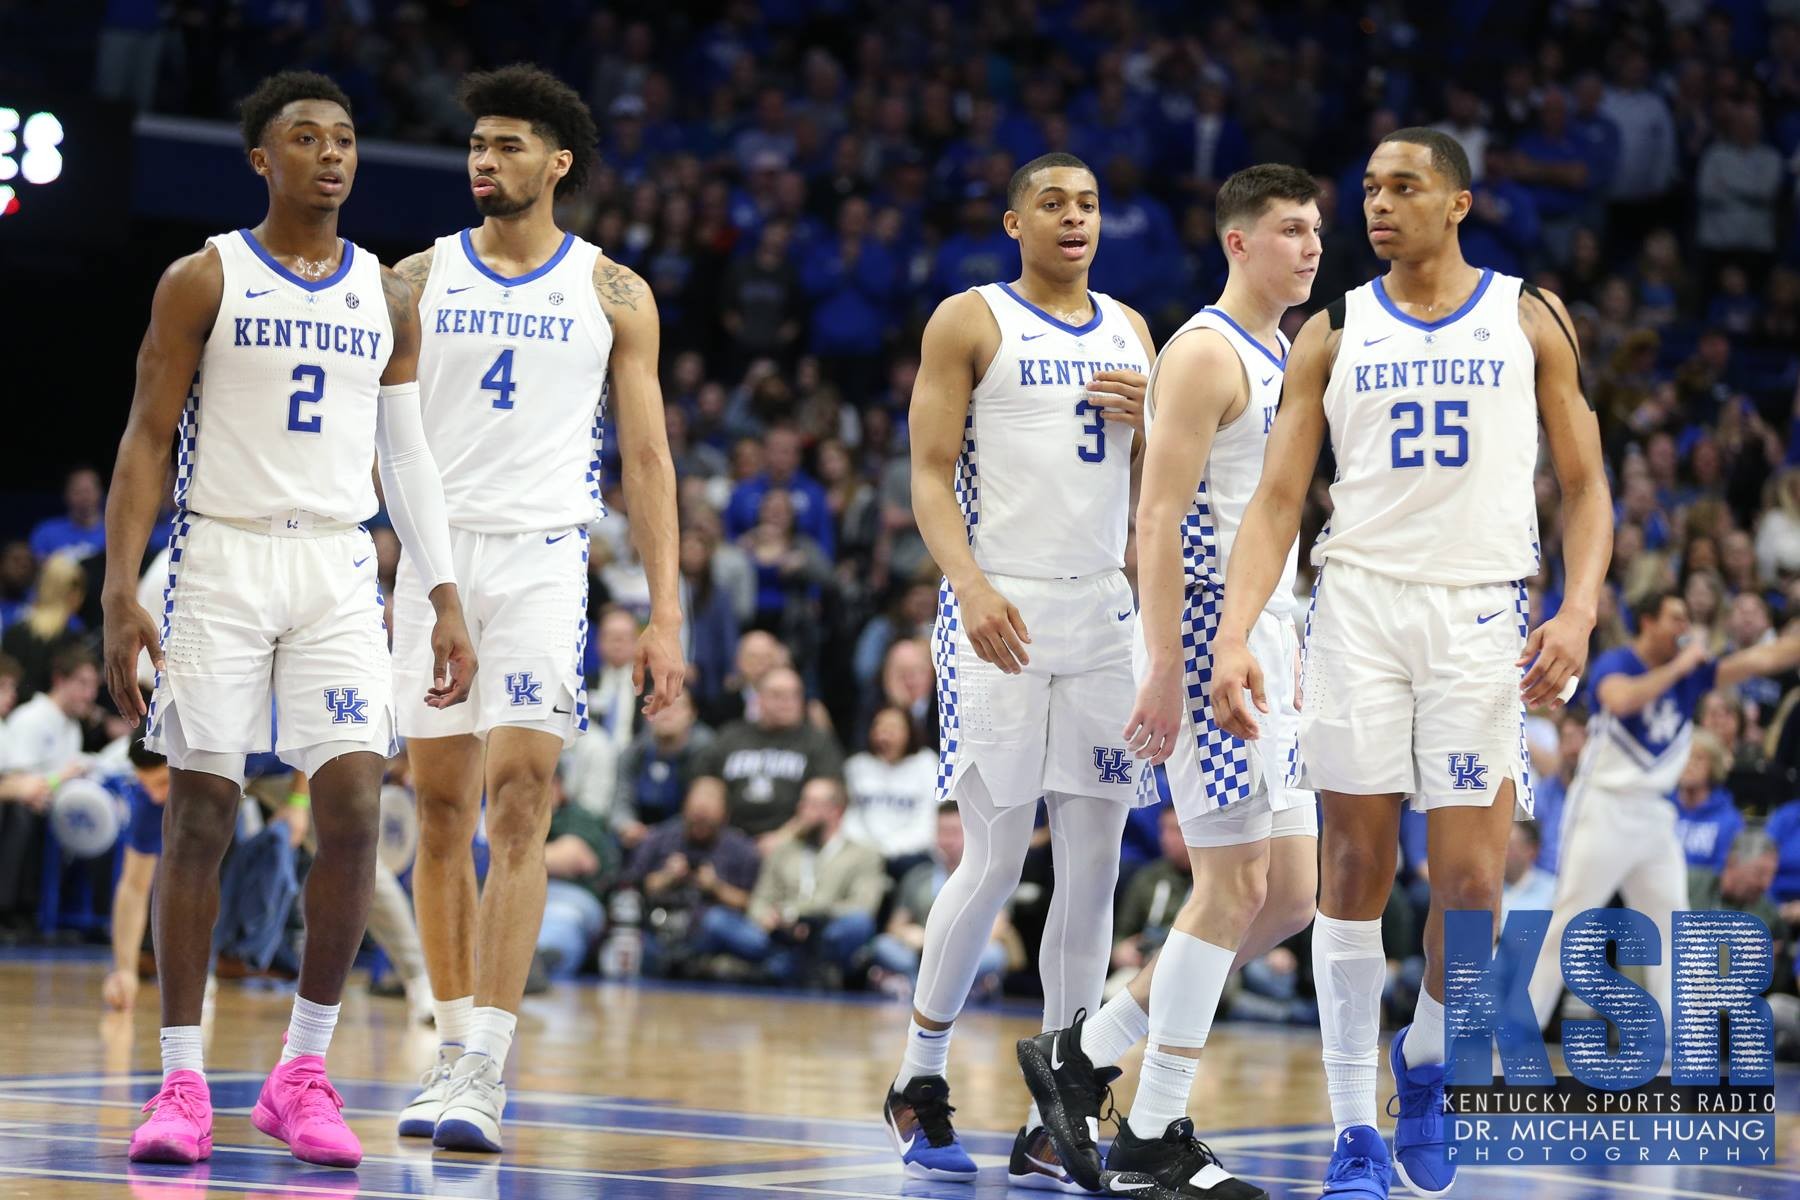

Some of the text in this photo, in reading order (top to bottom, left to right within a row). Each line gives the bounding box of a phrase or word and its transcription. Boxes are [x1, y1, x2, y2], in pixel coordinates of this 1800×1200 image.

[234, 317, 381, 360] KENTUCKY
[435, 309, 574, 342] KENTUCKY
[480, 348, 517, 410] 4
[1019, 359, 1142, 386] KENT
[1355, 358, 1505, 393] KENTUCKY
[287, 363, 326, 433] 2
[1075, 399, 1106, 463] 3
[1390, 400, 1469, 468] 25
[324, 687, 369, 724] UK
[504, 671, 543, 706] UK
[1093, 746, 1133, 784] UK
[1447, 753, 1488, 789] UK
